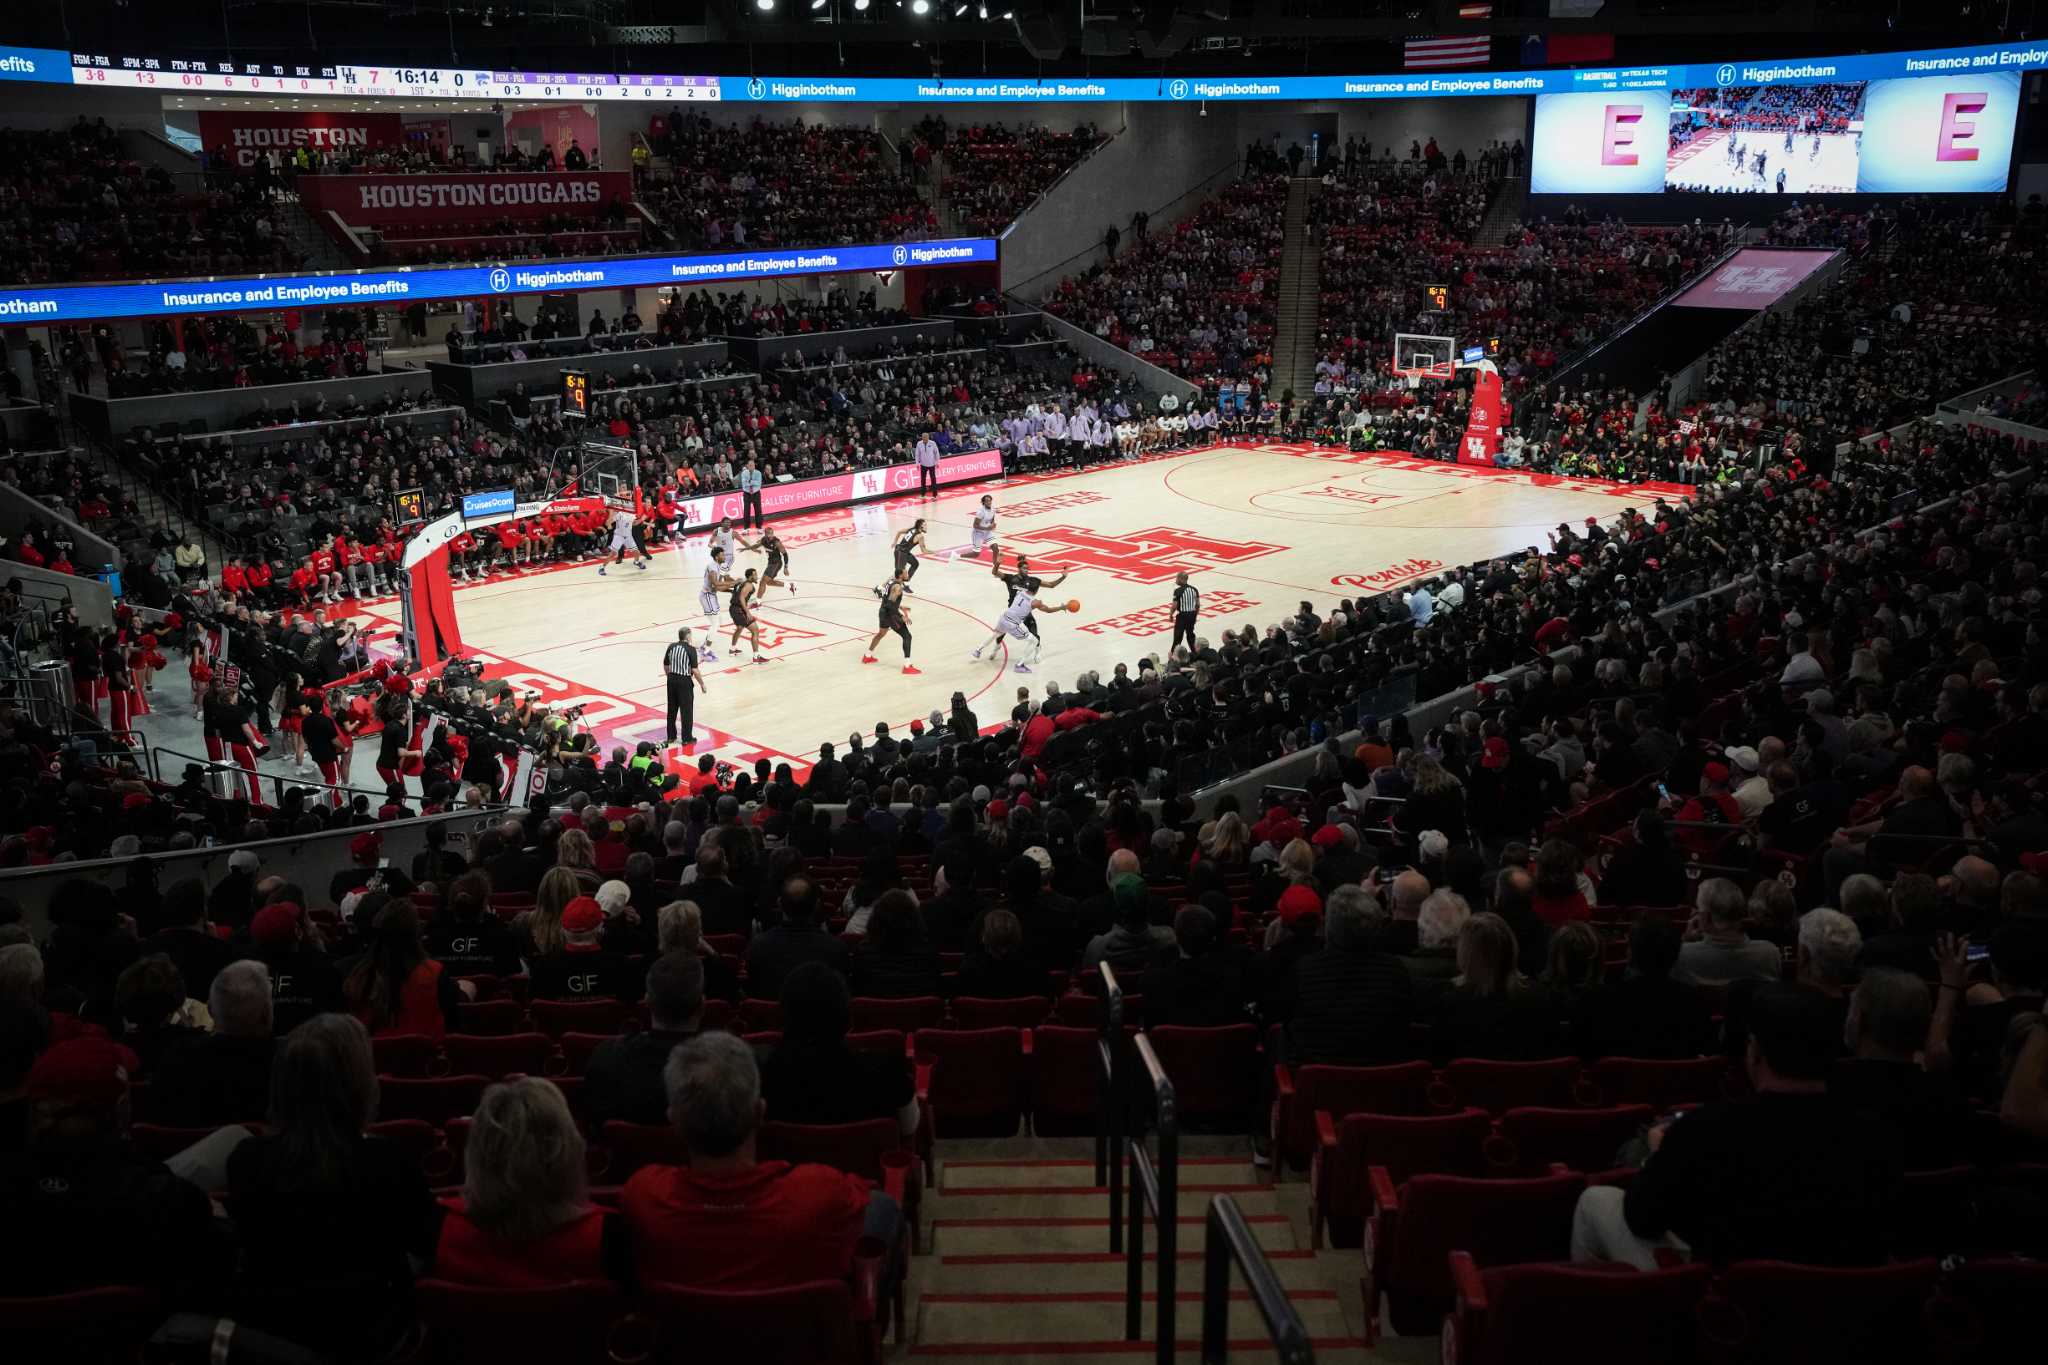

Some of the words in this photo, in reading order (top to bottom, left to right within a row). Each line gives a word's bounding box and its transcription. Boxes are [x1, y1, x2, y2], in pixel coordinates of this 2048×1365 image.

[1906, 57, 1969, 71] Insurance
[1972, 52, 1997, 66] and
[246, 64, 261, 74] AST
[273, 66, 284, 75] TO
[322, 68, 335, 77] STL
[369, 70, 379, 84] 7
[394, 69, 439, 85] 16:14
[454, 73, 463, 87] 0
[1743, 64, 1836, 82] Higginbotham
[224, 76, 233, 87] 6
[251, 78, 259, 88] 0
[277, 78, 284, 89] 1
[301, 79, 309, 89] 0
[328, 80, 334, 90] 1
[772, 83, 856, 98] Higginbotham
[918, 85, 973, 96] Insurance
[976, 85, 997, 96] and
[1000, 85, 1055, 98] Employee
[1058, 85, 1105, 96] Benefits
[1194, 82, 1280, 97] Higginbotham
[1345, 82, 1404, 93] Insurance
[1406, 80, 1429, 91] and
[1432, 79, 1491, 93] Employee
[1493, 77, 1544, 90] Benefits
[622, 88, 629, 97] 2
[645, 88, 651, 97] 0
[666, 89, 673, 97] 2
[687, 89, 694, 98] 2
[710, 89, 716, 98] 0
[1602, 104, 1644, 166] E
[1936, 92, 1988, 162] E
[232, 127, 368, 147] HOUSTON
[360, 183, 486, 209] HOUSTON
[489, 181, 601, 206] COUGARS
[911, 247, 973, 262] Higginbotham
[672, 263, 724, 276] Insurance
[726, 260, 745, 272] and
[747, 257, 796, 272] Employee
[797, 255, 838, 268] Benefits
[516, 270, 604, 287] Higginbotham
[163, 292, 242, 307] Insurance
[245, 287, 273, 301] and
[277, 284, 348, 301] Employee
[351, 280, 409, 296] Benefits
[1436, 295, 1444, 309] 9
[575, 389, 584, 411] 9
[958, 459, 997, 473] FURNITURE
[797, 484, 844, 501] FURNITURE
[410, 504, 418, 517] 9
